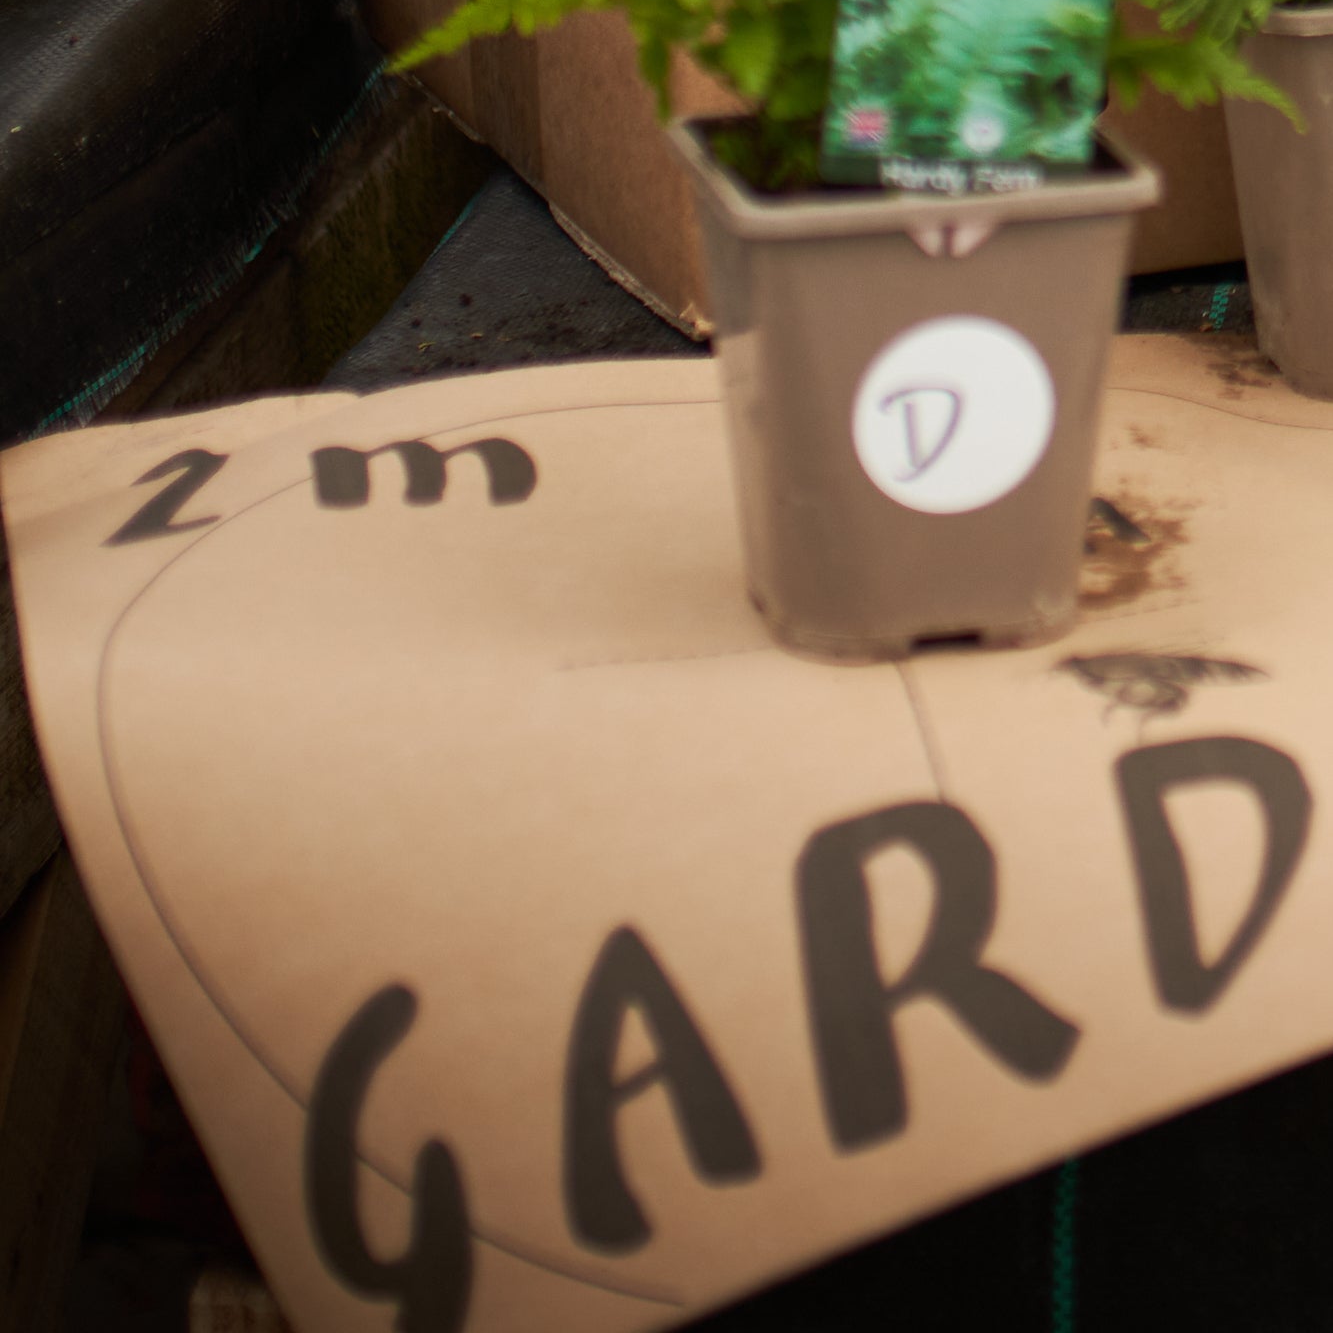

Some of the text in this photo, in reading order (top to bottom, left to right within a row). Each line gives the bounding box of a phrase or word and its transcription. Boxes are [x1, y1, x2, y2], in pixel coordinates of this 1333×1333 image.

[880, 159, 967, 196] Hardy
[879, 386, 962, 484] D
[100, 435, 539, 549] 2 m
